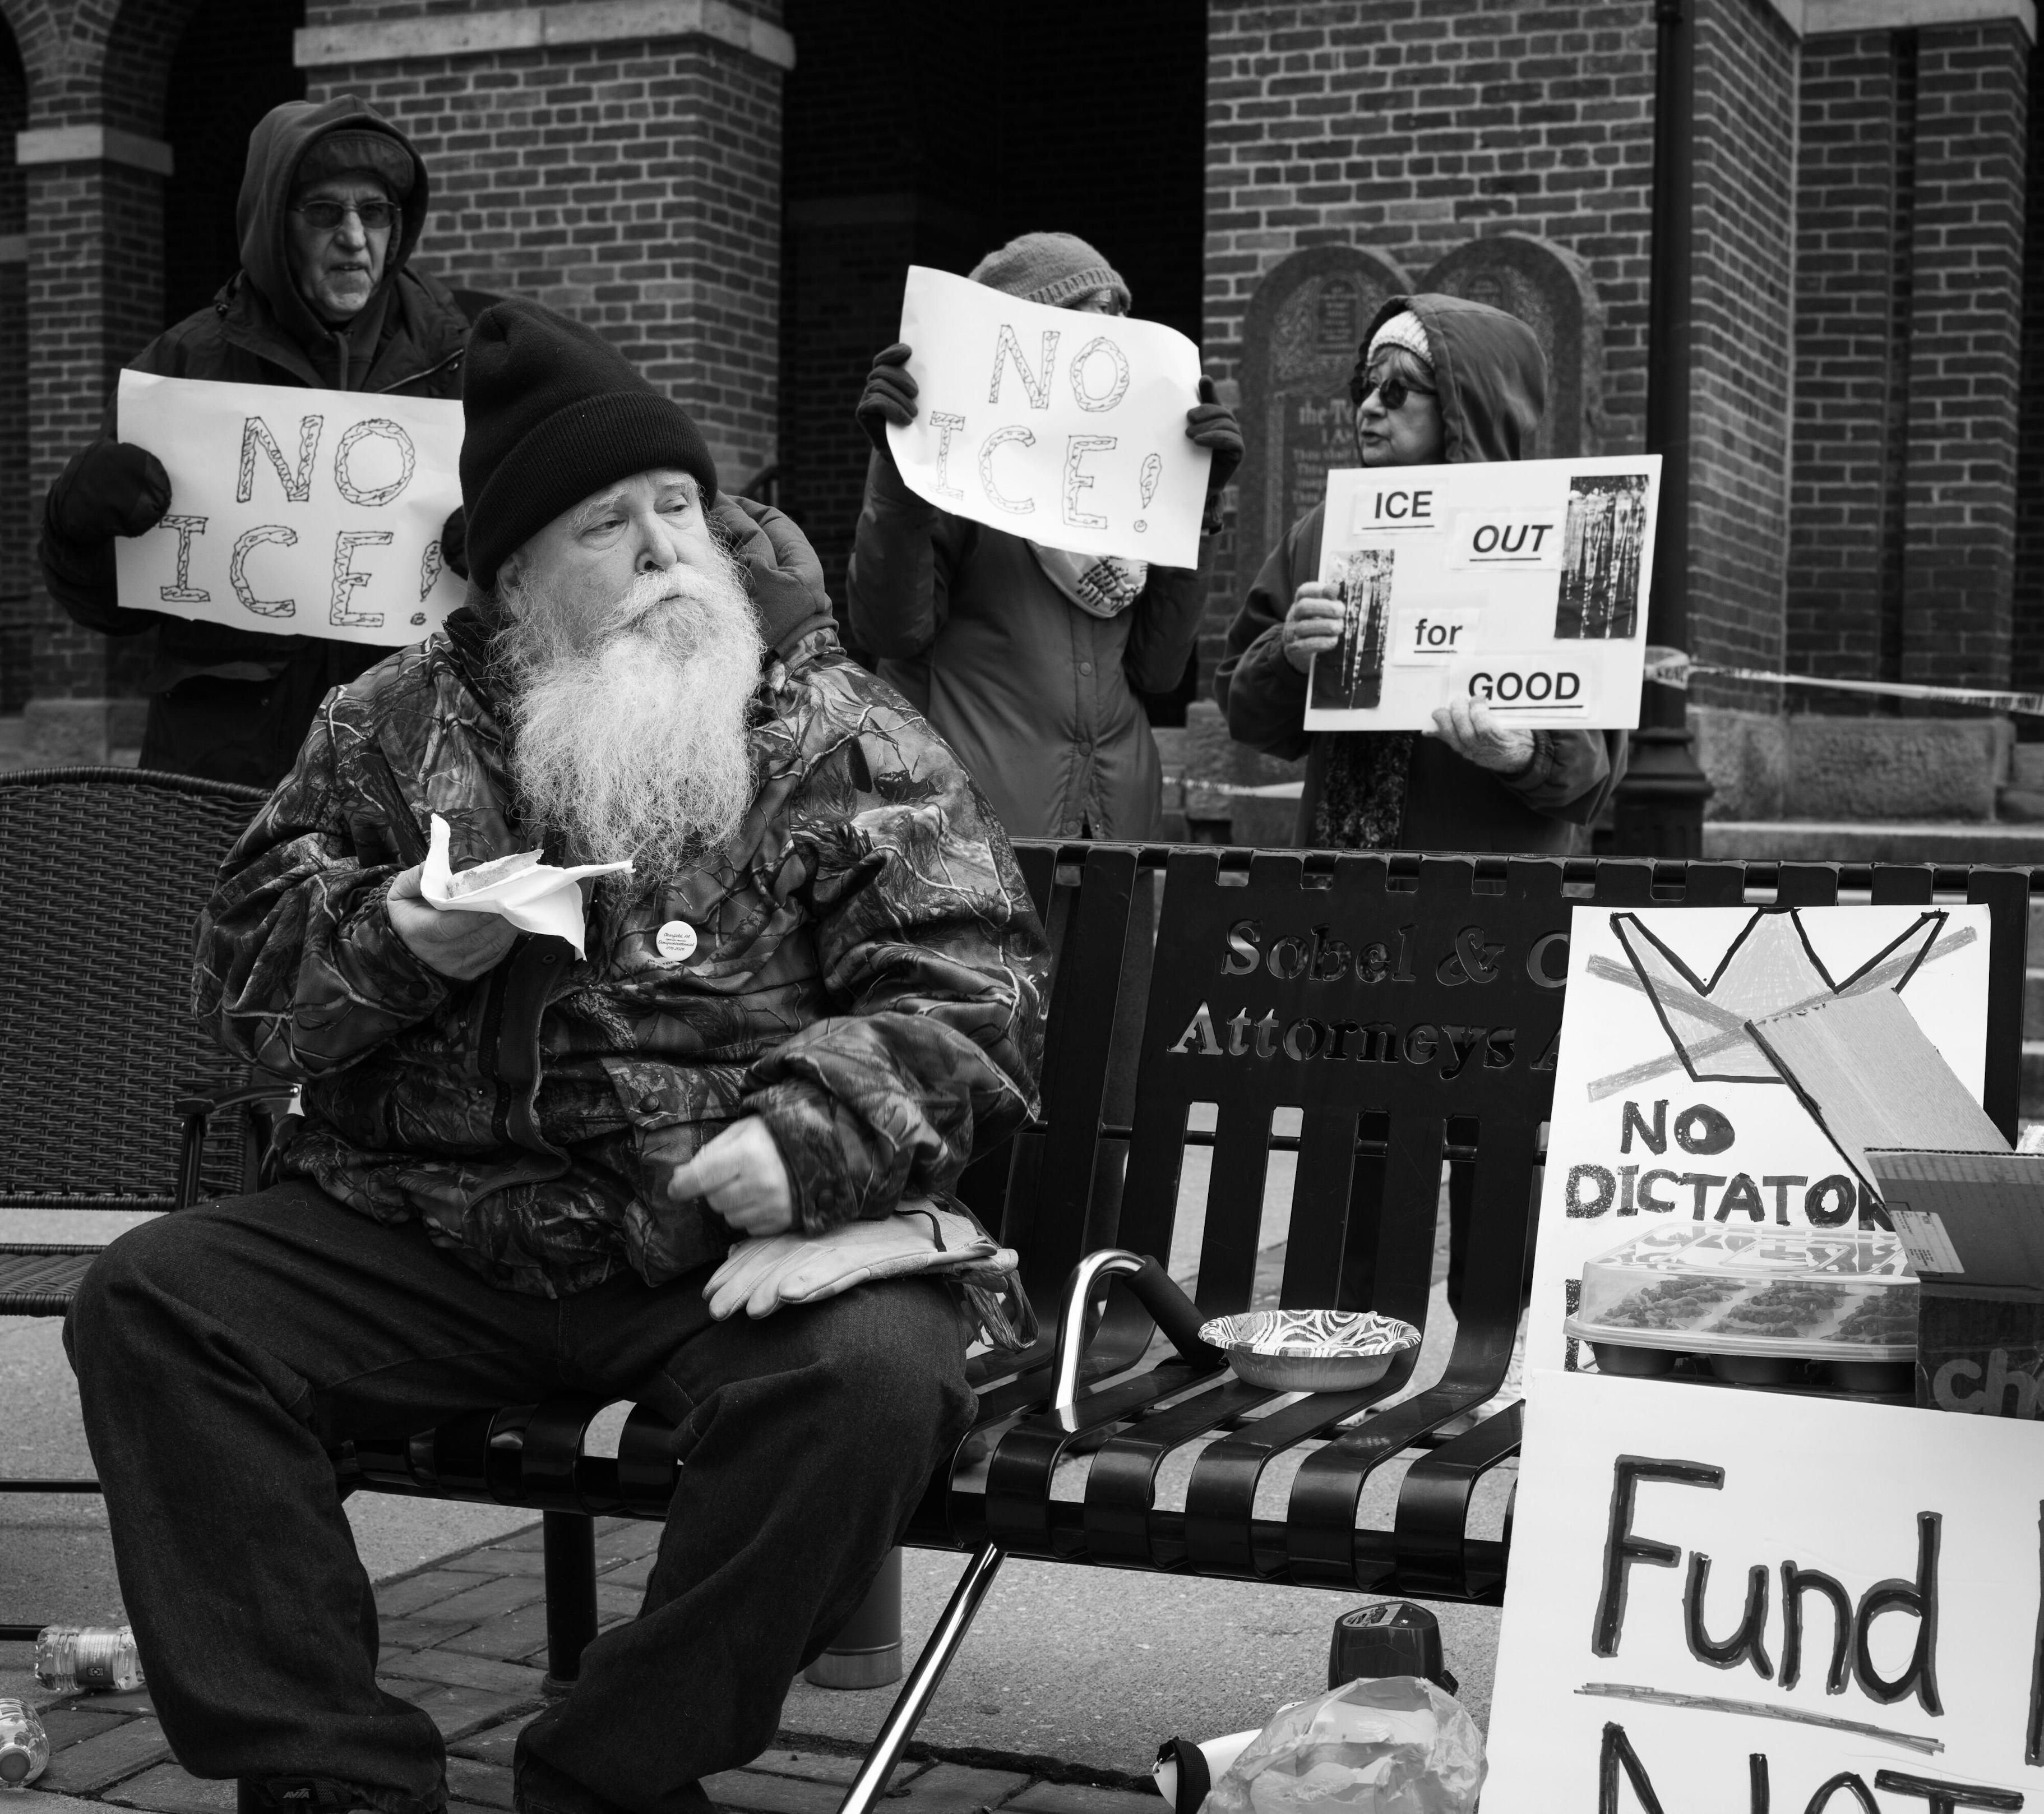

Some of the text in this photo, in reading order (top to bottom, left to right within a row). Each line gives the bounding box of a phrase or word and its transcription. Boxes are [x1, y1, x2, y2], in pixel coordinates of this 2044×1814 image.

[988, 324, 1130, 413] NO
[237, 414, 415, 507] NO
[926, 410, 1162, 533] ICE!
[1374, 491, 1433, 519] ICE
[1472, 524, 1553, 552] OUT
[159, 515, 443, 627] ICE!
[1416, 618, 1463, 645] for
[1468, 672, 1580, 700] GOOD
[1220, 918, 1419, 984] Sobel
[1436, 925, 1505, 986] &
[1167, 999, 1516, 1081] Attorneys
[1620, 1098, 1736, 1156] NO
[1934, 1347, 2044, 1421] ch
[1592, 1454, 1944, 1716] Fund
[283, 1788, 311, 1799] AVIA
